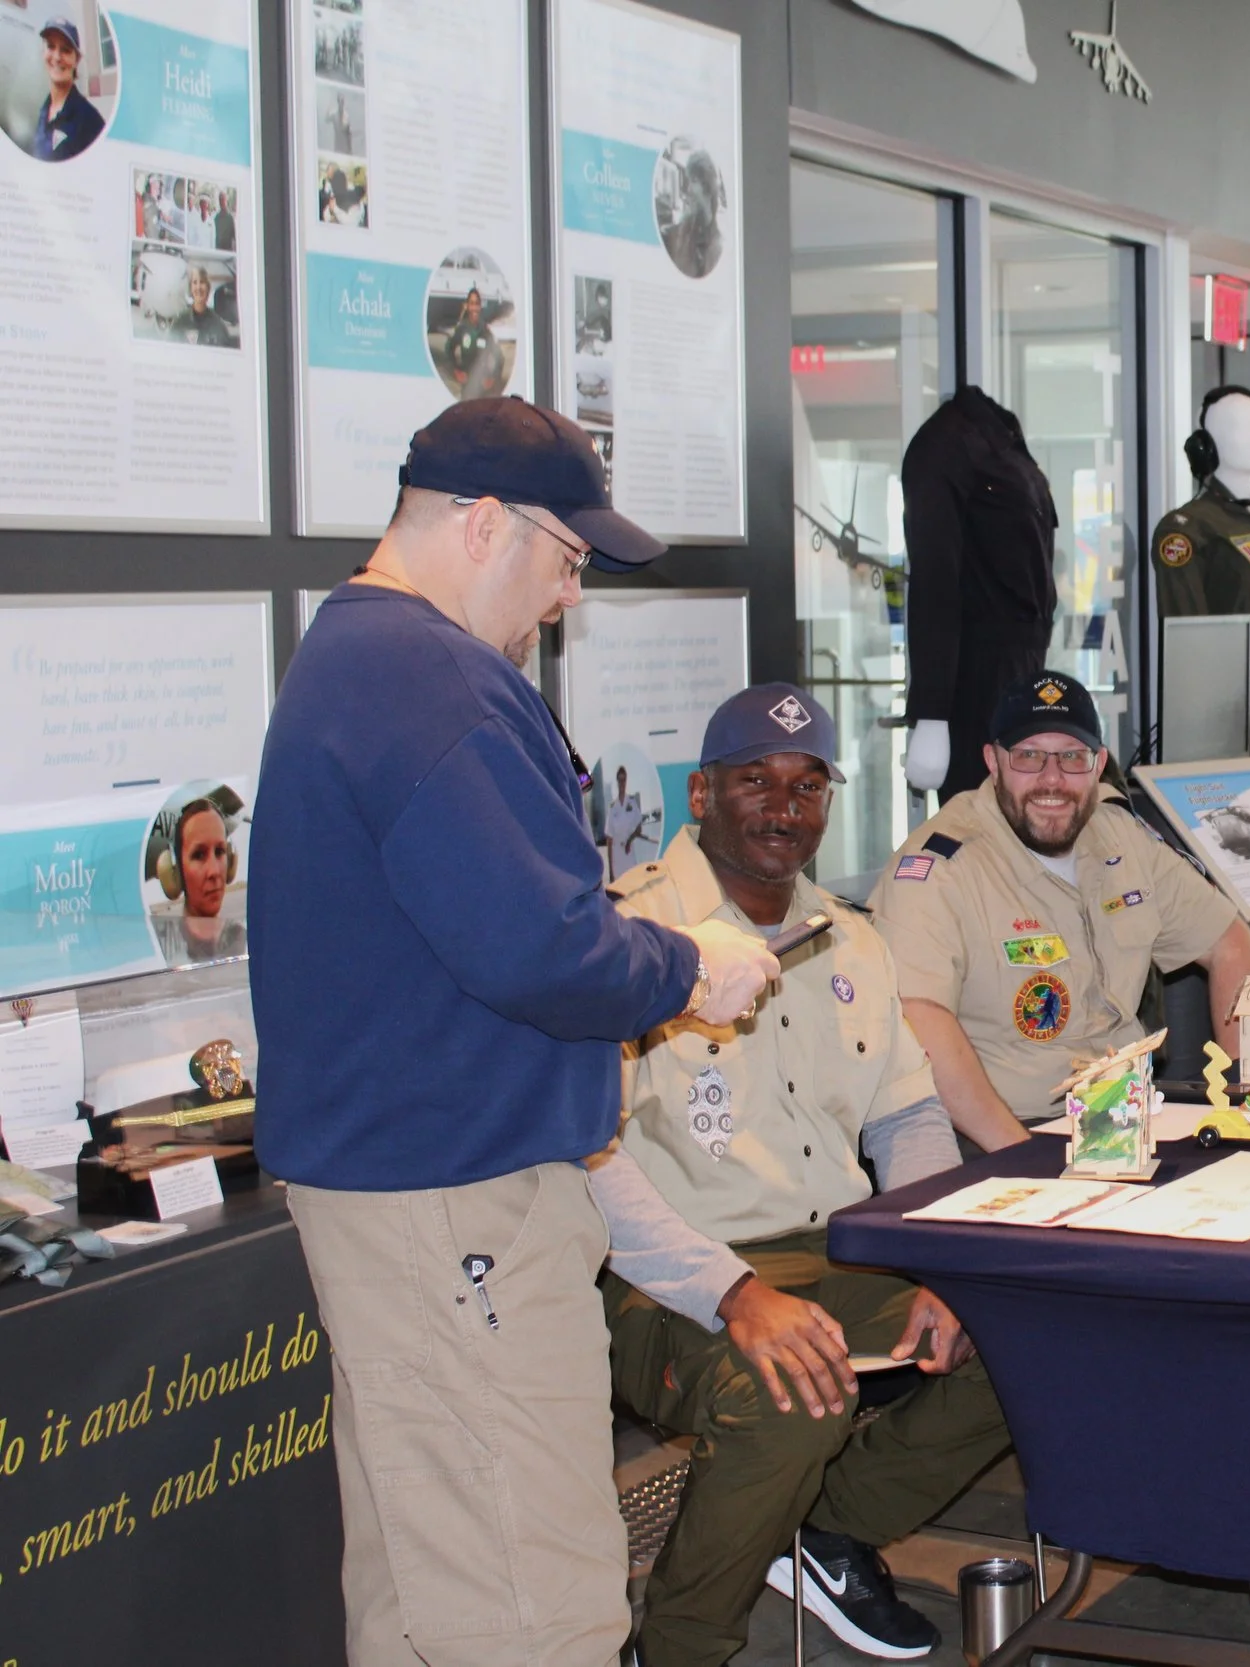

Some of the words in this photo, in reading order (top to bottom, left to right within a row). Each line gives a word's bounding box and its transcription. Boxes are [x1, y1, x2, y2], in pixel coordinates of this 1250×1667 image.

[163, 60, 213, 99] Heidi
[338, 288, 392, 318] Achala
[54, 841, 76, 853] Meet
[35, 858, 96, 896] Molly
[1024, 919, 1041, 929] BSA
[39, 1409, 71, 1463] it
[81, 1365, 155, 1448] and
[163, 1323, 275, 1416] should
[281, 1312, 319, 1371] do
[18, 1492, 137, 1575] smart,
[150, 1437, 222, 1518] and
[227, 1393, 332, 1487] skilled
